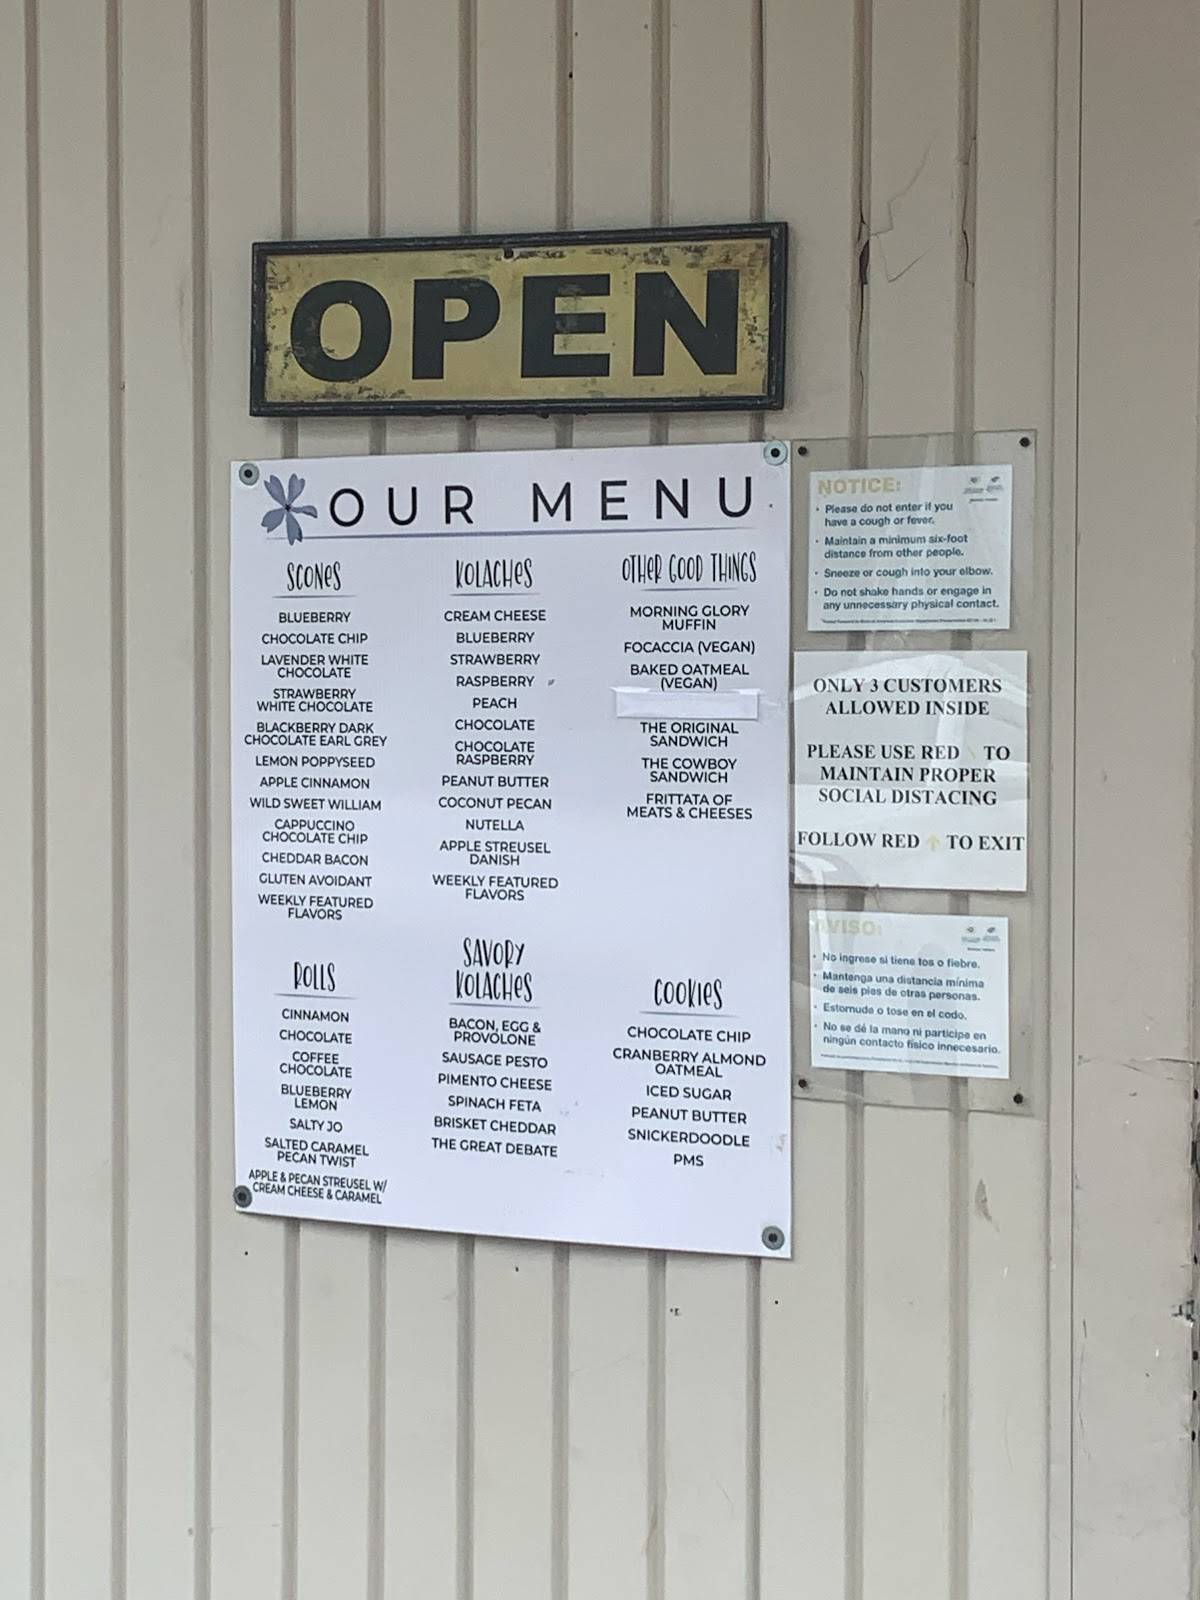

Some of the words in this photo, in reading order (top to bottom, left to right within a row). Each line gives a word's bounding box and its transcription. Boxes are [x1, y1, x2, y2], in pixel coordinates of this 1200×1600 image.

[290, 269, 739, 383] OPEN
[817, 477, 901, 495] NOTICE:
[329, 484, 475, 527] OUR
[531, 476, 753, 523] MENU
[825, 504, 857, 513] Please
[860, 504, 873, 513] do
[876, 503, 892, 512] not
[895, 503, 921, 512] enter
[924, 502, 932, 511] if
[934, 503, 953, 513] you
[825, 537, 867, 546] Maintain
[869, 537, 875, 545] a
[878, 536, 926, 544] minimum
[929, 535, 968, 543] six-foot
[824, 550, 866, 559] distance
[869, 549, 893, 557] from
[896, 548, 923, 557] other
[926, 548, 963, 558] people.
[669, 554, 703, 583] GOOD
[279, 612, 351, 623] BLUEBERRY
[444, 610, 491, 622] CREAM
[494, 610, 546, 621] CHEESE
[630, 606, 698, 617] MORNING
[702, 605, 749, 617] GLORY
[662, 619, 716, 630] MUFFIN
[262, 633, 334, 644] CHOCOLATE
[338, 633, 368, 644] CHIP
[456, 632, 535, 643] BLUEBERRY
[624, 642, 694, 653] FOCACCIA
[698, 641, 755, 655] (VEGAN)
[261, 655, 325, 665] LAVENDER
[328, 654, 368, 665] WHITE
[450, 654, 540, 665] STRAWBERRY
[277, 667, 351, 678] CHOCOLATE
[630, 664, 678, 675] BAKED
[682, 664, 749, 675] OATMEAL
[456, 676, 535, 687] RASPBERRY
[661, 677, 717, 691] (VEGAN)
[813, 678, 865, 693] ONLY
[870, 678, 879, 692] 3
[884, 678, 1002, 693] CUSTOMERS
[273, 688, 356, 699] STRAWBERRY
[257, 701, 295, 712] WHITE
[298, 701, 373, 712] CHOCOLATE
[472, 698, 517, 708] PEACH
[826, 700, 920, 715] ALLOWED
[926, 701, 990, 715] INSIDE
[257, 722, 336, 733] BLACKBERRY
[339, 722, 374, 733] DARK
[455, 719, 535, 730] CHOCOLATE
[640, 722, 666, 733] THE
[671, 722, 739, 734] ORIGINAL
[244, 734, 316, 746] CHOCOLATE
[320, 735, 351, 746] EARL
[354, 736, 387, 746] GREY
[455, 741, 535, 752] CHOCOLATE
[650, 736, 728, 747] SANDWICH
[807, 744, 875, 759] PLEASE
[881, 745, 916, 759] USE
[921, 745, 960, 760] RED
[984, 746, 1010, 761] TO
[255, 756, 298, 767] LEMON
[301, 756, 375, 768] POPPYSEED
[456, 754, 535, 765] RASPBERRY
[642, 758, 668, 769] THE
[672, 758, 737, 770] COWBOY
[650, 771, 728, 783] SANDWICH
[820, 767, 913, 781] MAINTAIN
[920, 768, 996, 782] PROPER
[260, 777, 298, 788] APPLE
[301, 777, 370, 789] CINNAMON
[442, 775, 494, 787] PEANUT
[498, 776, 549, 788] BUTTER
[438, 797, 503, 808] COCONUT
[507, 798, 551, 809] PECAN
[646, 793, 709, 805] FRITTATA
[713, 795, 732, 806] OF
[818, 788, 886, 803] SOCIAL
[892, 790, 997, 805] DISTACING
[250, 798, 281, 808] WILD
[284, 798, 325, 809] SWEET
[328, 799, 382, 810] WILLIAM
[627, 807, 672, 818] MEATS
[676, 808, 685, 818] &
[689, 808, 752, 820] CHEESES
[274, 819, 355, 831] CAPPUCCINO
[466, 819, 524, 831] NUTELLA
[262, 831, 335, 843] CHOCOLATE
[338, 833, 368, 844] CHIP
[798, 831, 876, 847] FOLLOW
[882, 834, 920, 848] RED
[946, 835, 973, 850] TO
[979, 836, 1024, 851] EXIT
[440, 840, 481, 852] APPLE
[485, 841, 551, 853] STREUSEL
[262, 852, 321, 864] CHEDDAR
[325, 854, 368, 866] BACON
[470, 854, 520, 865] DANISH
[259, 873, 306, 885] GLUTEN
[308, 875, 372, 887] AVOIDANT
[258, 894, 306, 906] WEEKLY
[309, 896, 373, 908] FEATURED
[288, 908, 342, 920] FLAVORS
[463, 937, 525, 969] SAVORY
[823, 953, 837, 961] No
[879, 956, 888, 964] si
[891, 956, 915, 965] tiene
[918, 958, 934, 966] tos
[947, 959, 980, 969] fiebre.
[294, 962, 335, 991] ROLLS
[823, 971, 873, 982] Mantenga
[875, 975, 895, 983] una
[897, 975, 943, 986] distancia
[946, 978, 984, 988] mínima
[281, 1008, 349, 1022] CINNAMON
[449, 1018, 498, 1032] BACON,
[502, 1020, 529, 1032] EGG
[533, 1022, 541, 1033] &
[279, 1029, 352, 1044] CHOCOLATE
[454, 1031, 536, 1046] PROVOLONE
[627, 1026, 712, 1041] CHOCOLATE
[717, 1030, 751, 1043] CHIP
[292, 1051, 339, 1064] COFFEE
[442, 1052, 502, 1066] SAUSAGE
[506, 1055, 548, 1069] PESTO
[613, 1048, 699, 1063] CRANBERRY
[702, 1052, 766, 1066] ALMOND
[279, 1063, 352, 1078] CHOCOLATE
[655, 1063, 723, 1078] OATMEAL
[438, 1073, 497, 1087] PIMENTO
[500, 1077, 552, 1091] CHEESE
[281, 1084, 352, 1099] BLUEBERRY
[647, 1085, 679, 1098] ICED
[683, 1087, 732, 1101] SUGAR
[295, 1099, 338, 1110] LEMON
[448, 1095, 505, 1109] SPINACH
[509, 1099, 541, 1112] FETA
[289, 1118, 324, 1131] SALTY
[327, 1121, 343, 1132] JO
[434, 1116, 487, 1130] BRISKET
[491, 1120, 556, 1135] CHEDDAR
[628, 1128, 750, 1147] SNICKERDOODLE
[432, 1137, 456, 1149] THE
[460, 1139, 502, 1153] GREAT
[506, 1143, 558, 1157] DEBATE
[674, 1154, 704, 1166] PMS
